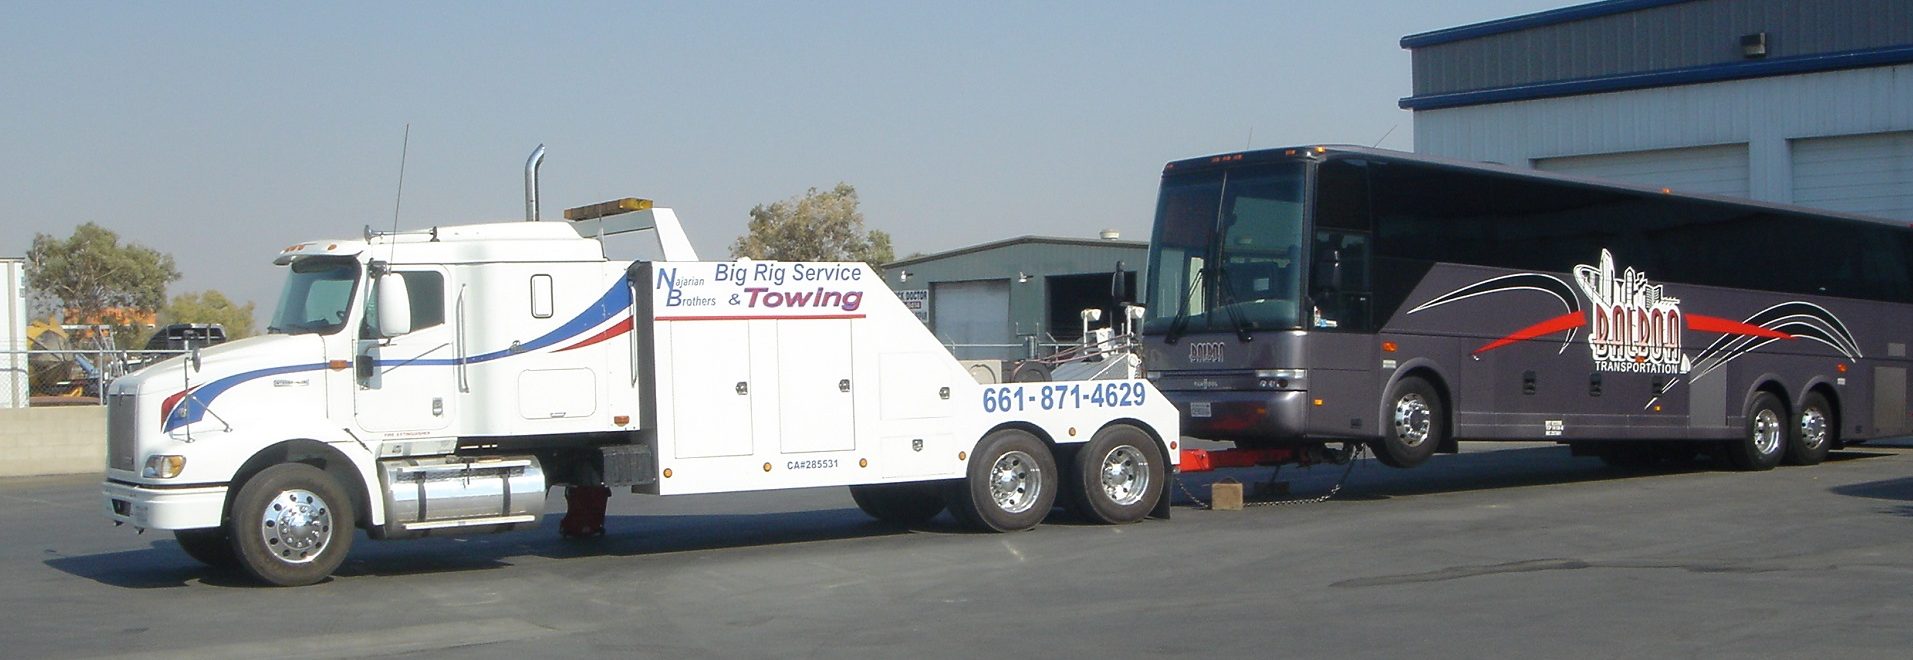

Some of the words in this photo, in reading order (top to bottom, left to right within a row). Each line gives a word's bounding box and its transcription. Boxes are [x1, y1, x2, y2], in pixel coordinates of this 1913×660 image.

[656, 268, 705, 289] Najarian
[714, 263, 747, 285] Big
[753, 263, 785, 285] Rig
[792, 263, 862, 281] Service
[666, 289, 716, 307] Brothers
[728, 293, 741, 305] &
[743, 287, 863, 311] Towing
[905, 290, 928, 300] DOCTOR
[1589, 301, 1681, 364] BALBOA
[1595, 360, 1678, 374] TRANSPORTATION
[787, 459, 839, 470] CA#285531
